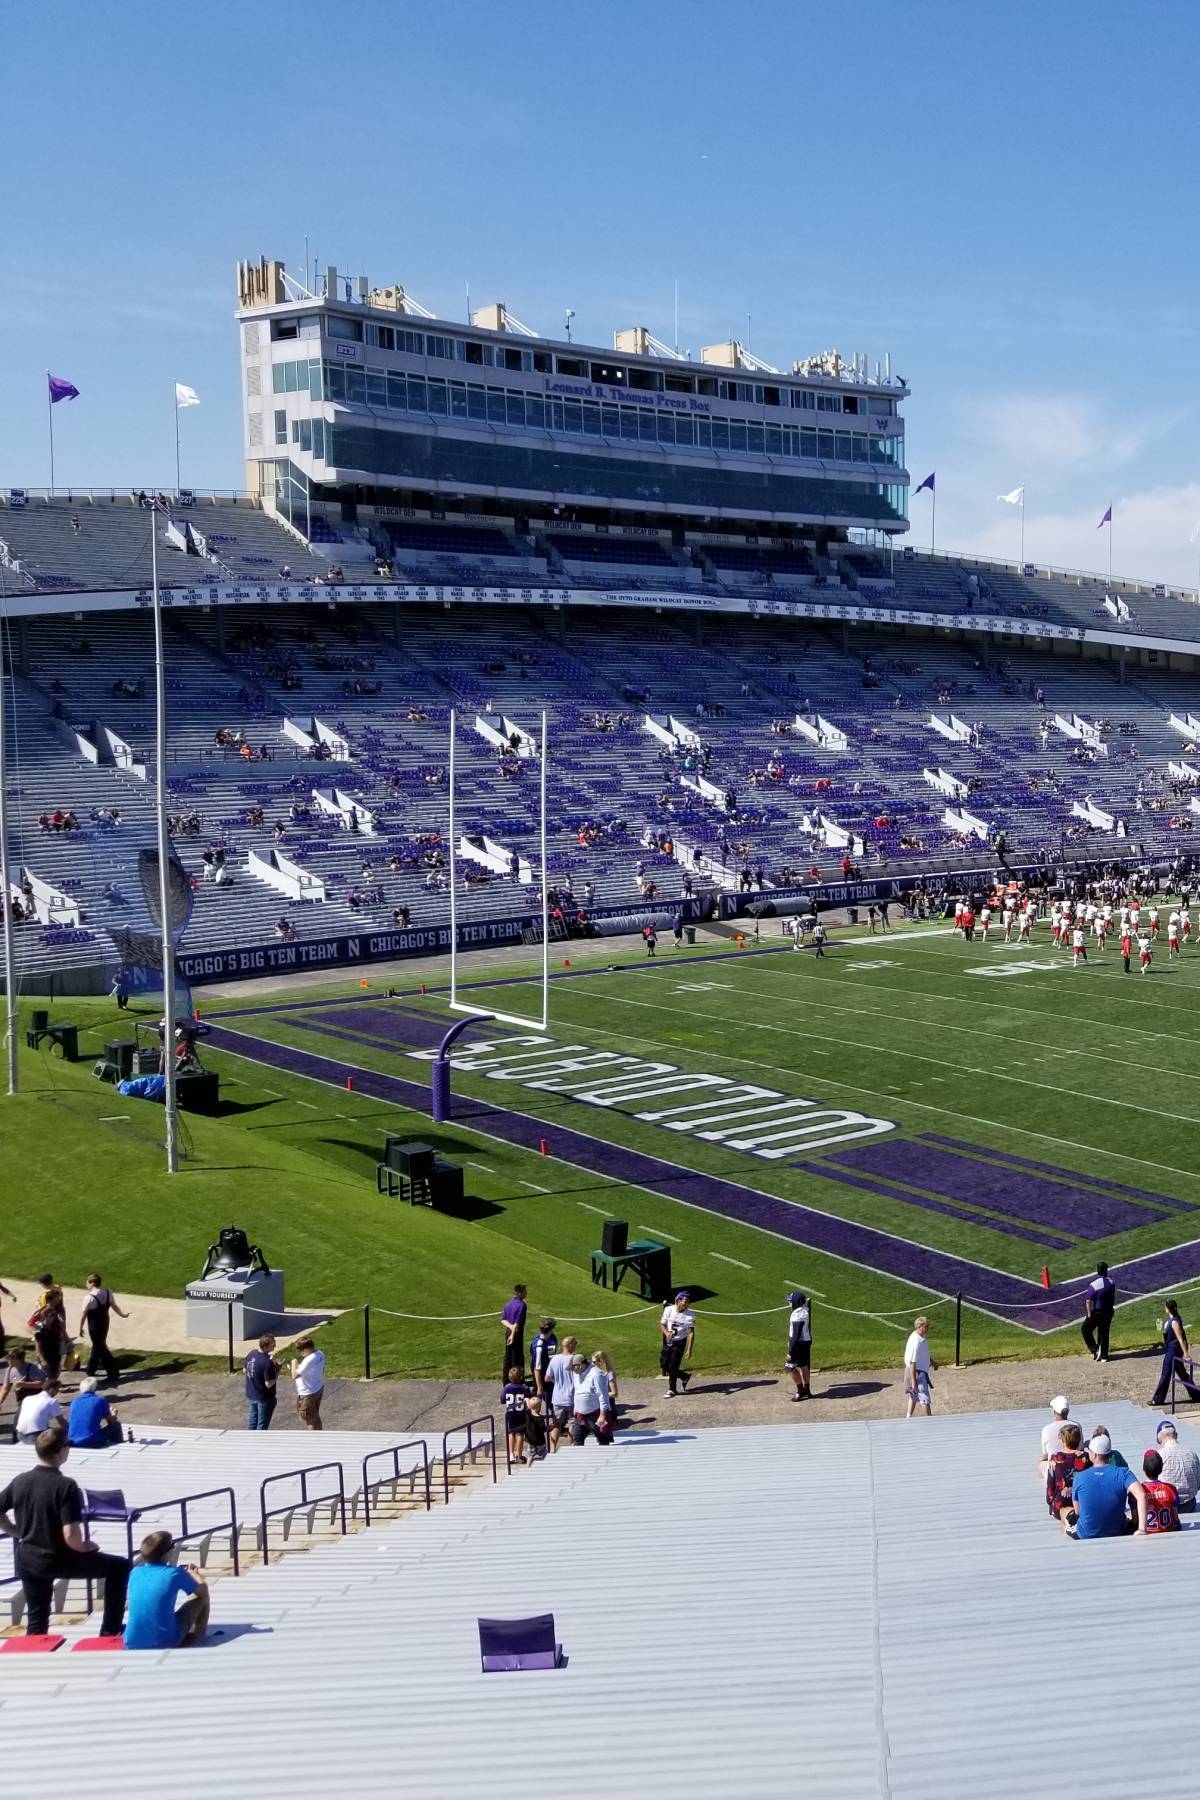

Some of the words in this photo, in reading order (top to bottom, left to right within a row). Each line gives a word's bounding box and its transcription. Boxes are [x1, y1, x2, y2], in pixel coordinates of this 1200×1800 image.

[544, 379, 592, 397] Leonard
[609, 388, 654, 405] Thomas
[656, 394, 687, 409] Press
[689, 398, 712, 412] Box
[691, 900, 701, 917] N
[727, 896, 738, 914] N
[827, 888, 848, 901] TEN
[850, 885, 877, 899] TEAM
[240, 953, 265, 972] BIG
[269, 951, 297, 969] TEN
[300, 943, 339, 964] TEAM
[347, 939, 361, 958] N
[369, 930, 437, 954] CHICAGO'S
[462, 925, 488, 942] TEN
[489, 921, 523, 939] TEAM
[403, 1035, 898, 1159] WILDCATS
[189, 1290, 208, 1298] TRUST
[209, 1291, 238, 1300] YOURSELF
[671, 1323, 679, 1337] 5
[1146, 1507, 1171, 1529] 20
